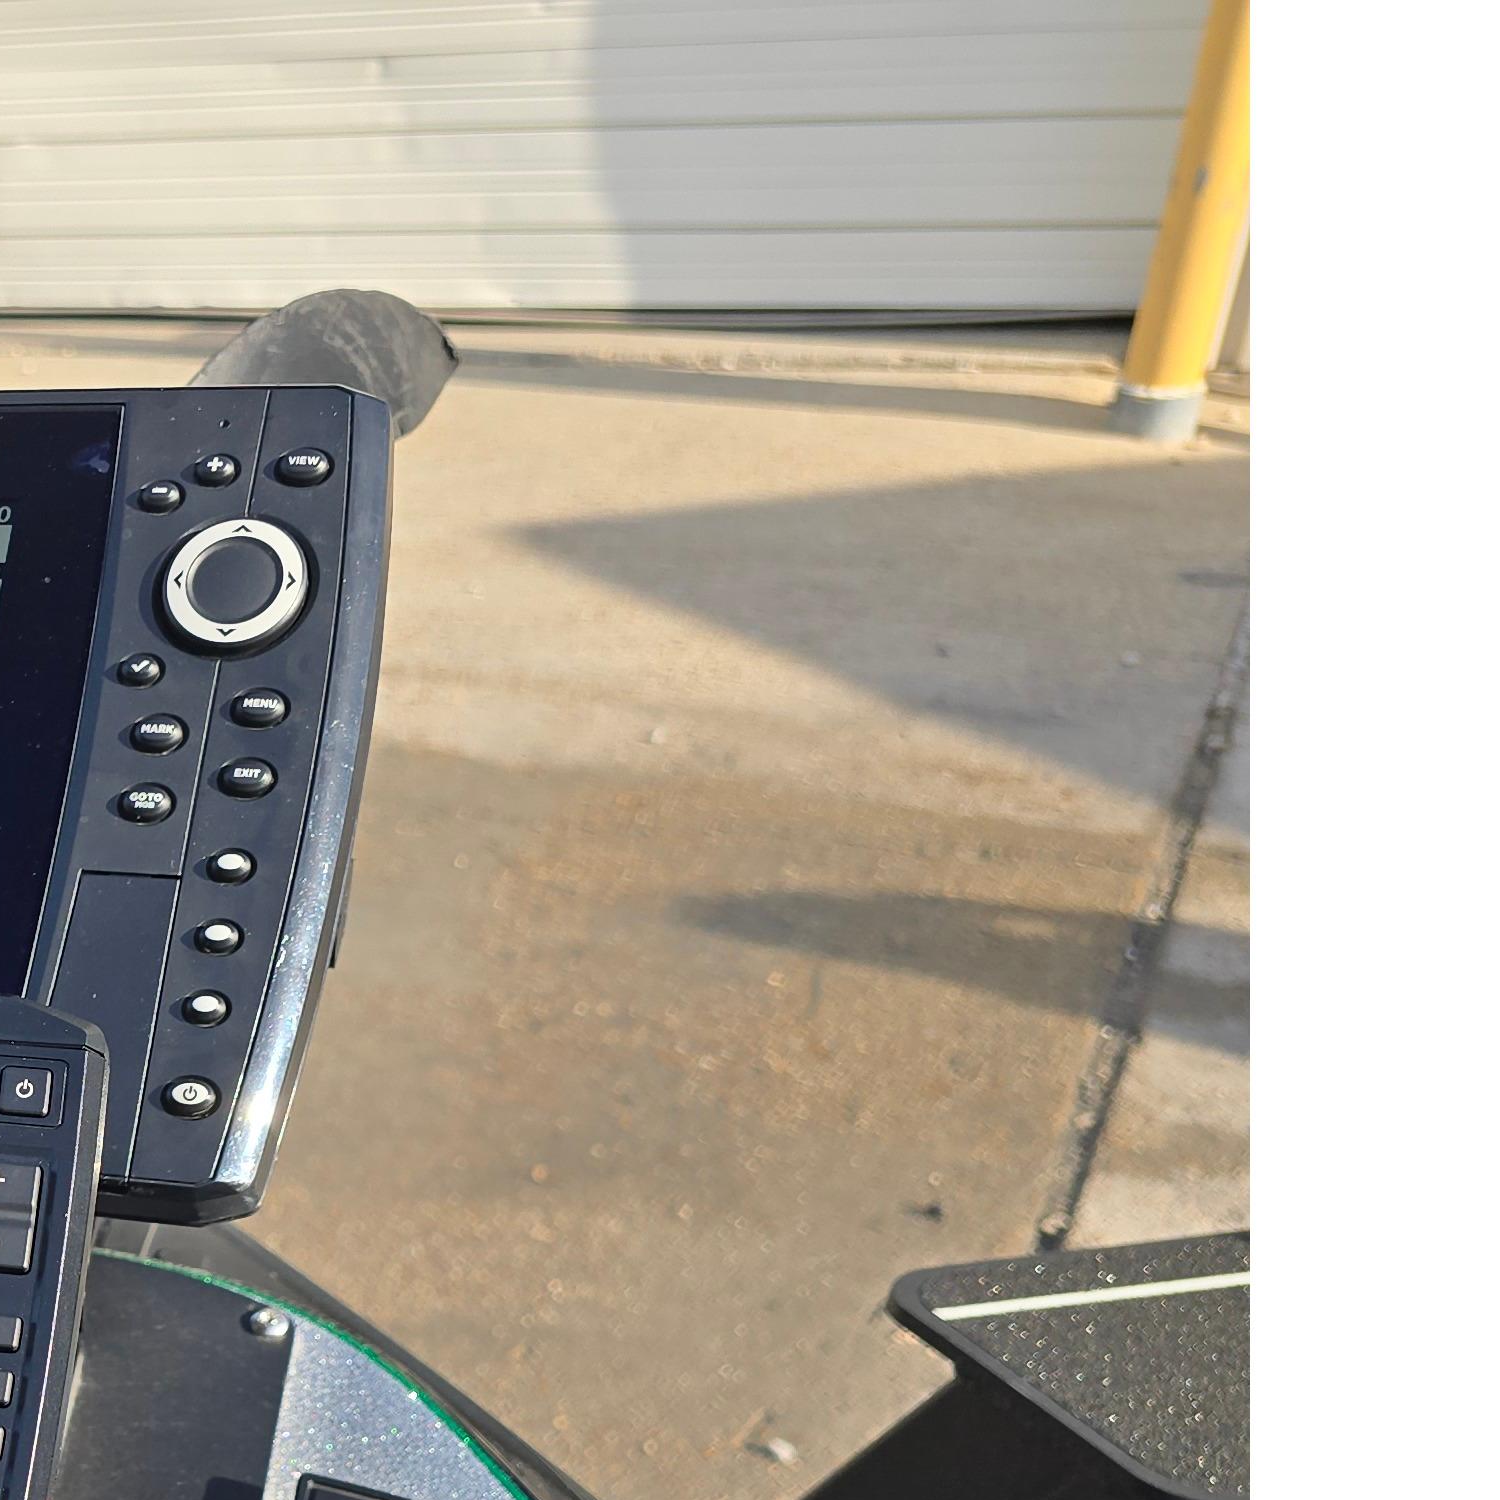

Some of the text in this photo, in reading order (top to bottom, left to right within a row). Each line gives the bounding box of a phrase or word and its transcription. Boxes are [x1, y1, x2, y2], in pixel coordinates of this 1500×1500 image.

[288, 455, 320, 467] VIEW
[242, 698, 279, 709] MENU
[140, 723, 175, 734] MARK
[234, 768, 261, 779] EXIT
[129, 792, 164, 803] GOTO
